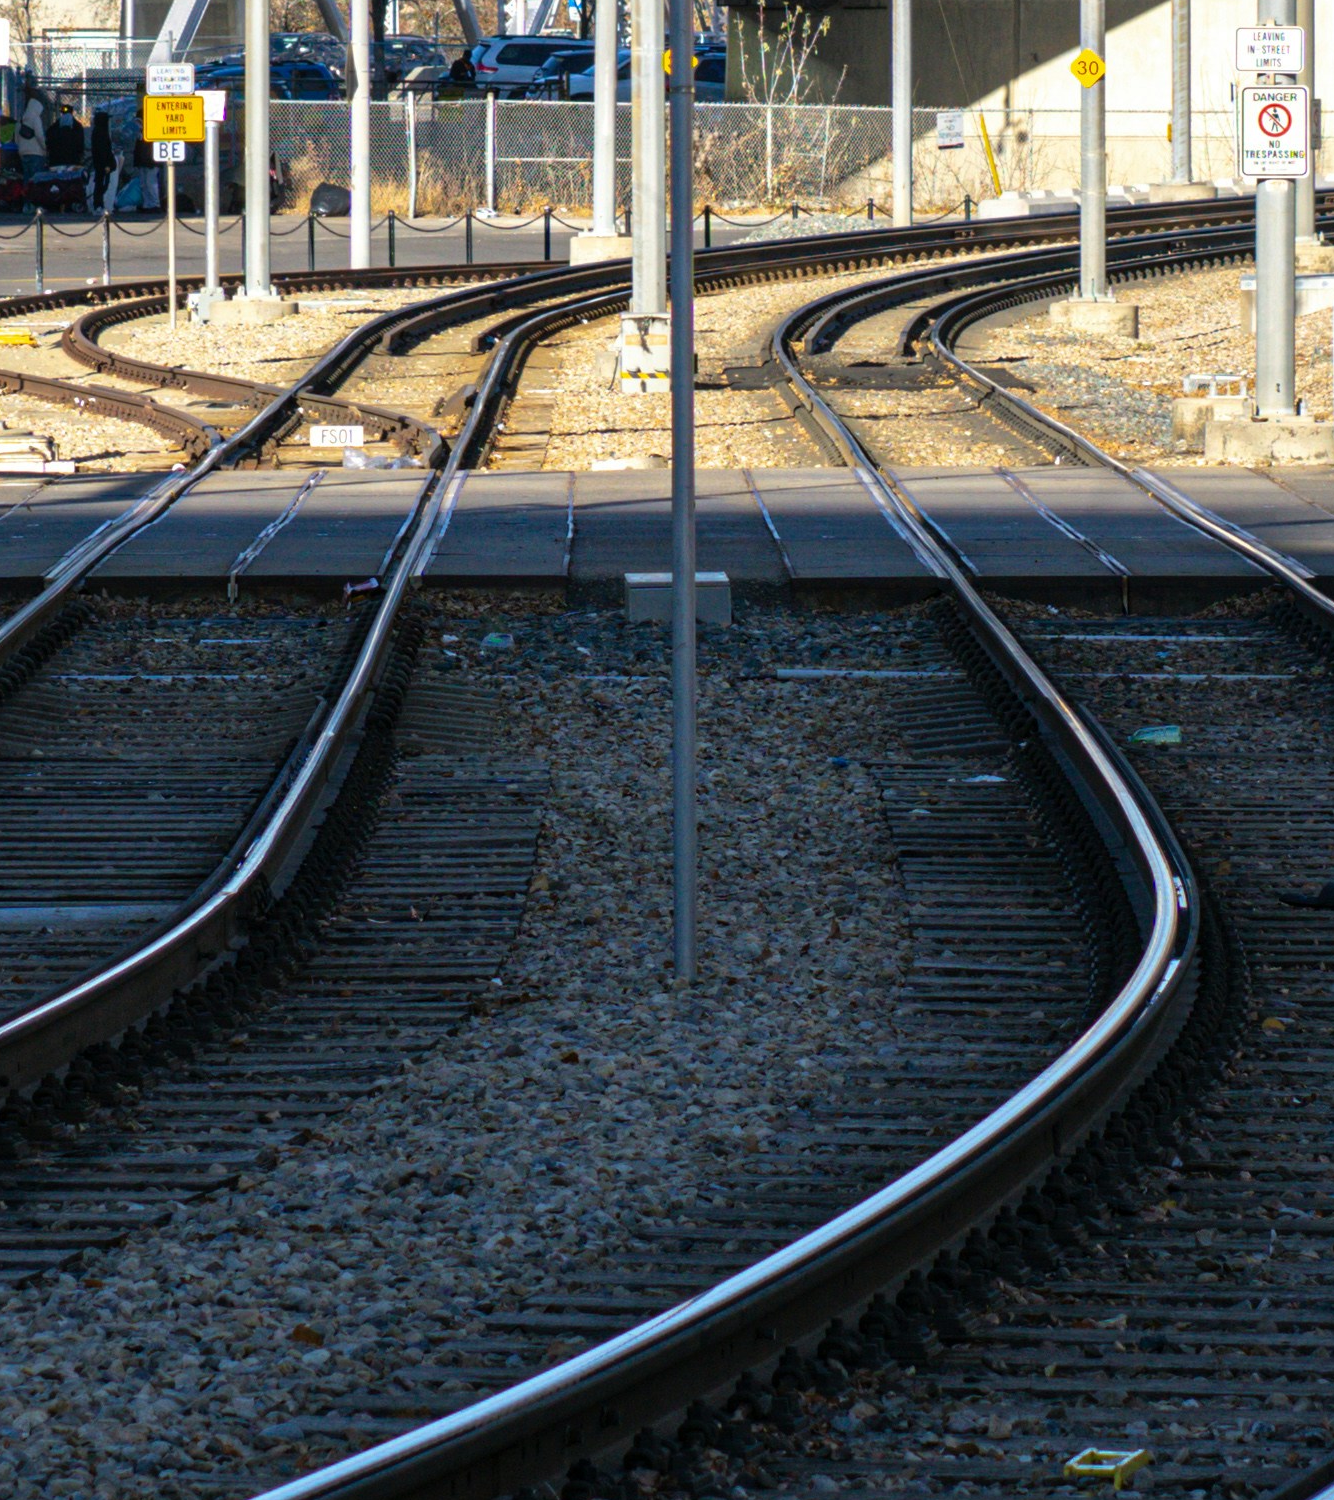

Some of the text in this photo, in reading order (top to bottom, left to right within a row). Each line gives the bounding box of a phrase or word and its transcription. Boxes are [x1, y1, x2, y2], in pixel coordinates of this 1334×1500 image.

[1253, 32, 1286, 42] LEAVING
[1256, 58, 1282, 67] LIMITS
[1077, 60, 1099, 75] 30
[1253, 92, 1298, 101] DANGER
[156, 101, 193, 111] ENTERING
[165, 114, 185, 123] YARD
[162, 126, 187, 135] LIMITS
[1269, 140, 1281, 149] NO
[159, 142, 181, 158] BE
[1245, 150, 1306, 159] TRESPASSING
